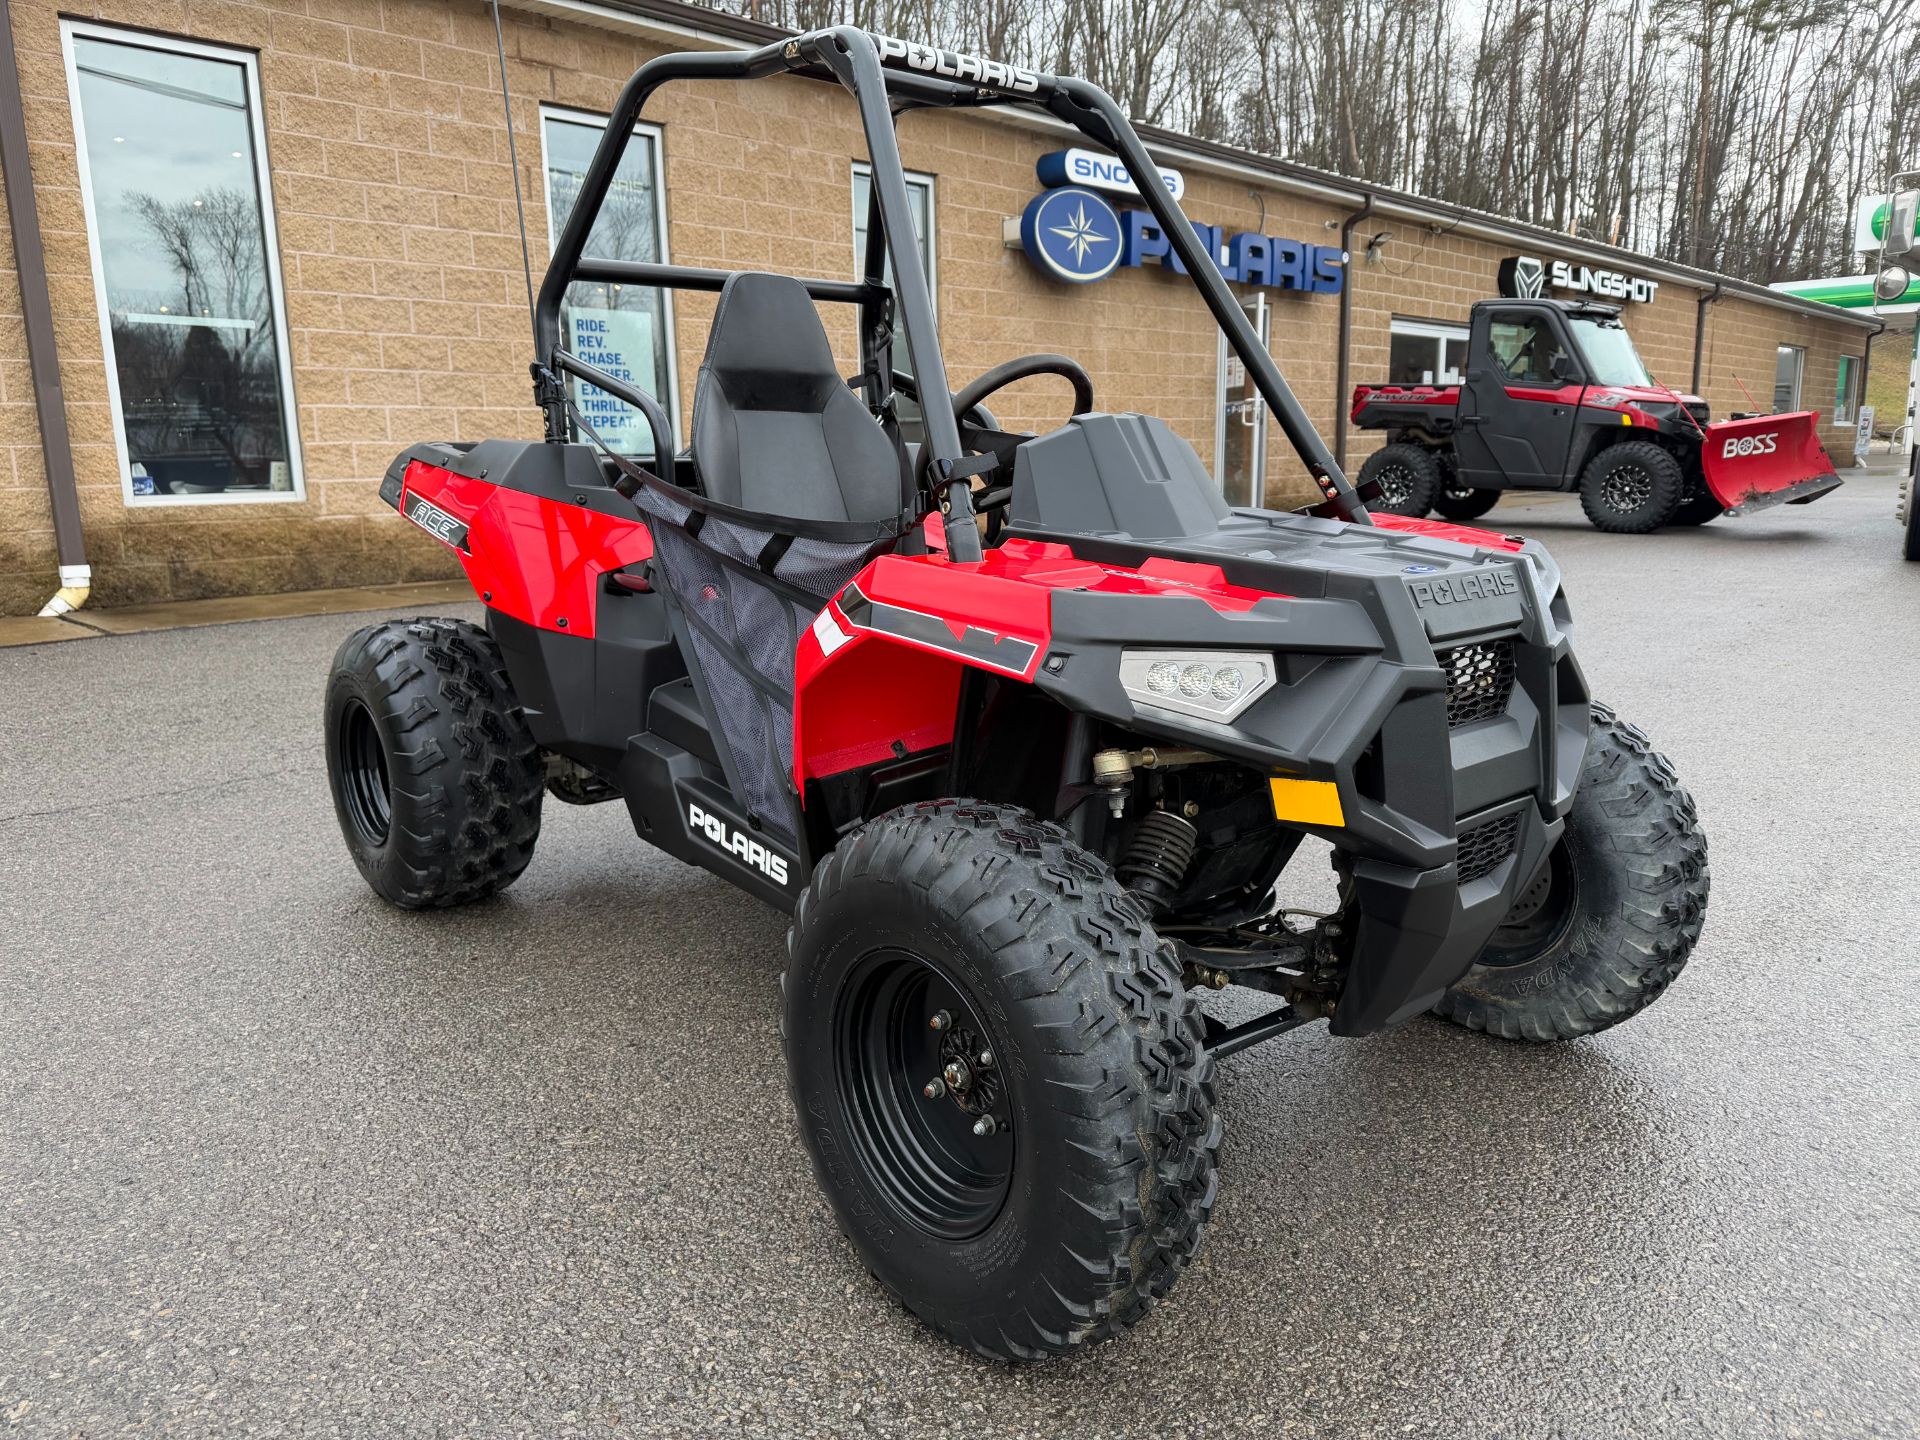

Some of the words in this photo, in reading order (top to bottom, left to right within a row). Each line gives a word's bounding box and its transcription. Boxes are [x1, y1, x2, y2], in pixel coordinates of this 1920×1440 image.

[879, 35, 1039, 93] POLARIS
[1075, 158, 1177, 193] SNOS
[1121, 209, 1343, 295] PLARIS
[1552, 260, 1659, 304] SLINGSHOT
[576, 319, 610, 333] RIDE.
[577, 335, 607, 349] REV.
[579, 351, 626, 366] CHASE.
[582, 400, 632, 412] THRILL.
[1723, 433, 1779, 458] BOSS
[411, 501, 459, 541] ACE
[1409, 569, 1519, 608] POLARIS
[689, 803, 788, 886] POLARIS
[1511, 913, 1602, 997] WANDA
[807, 1091, 895, 1253] WANDA
